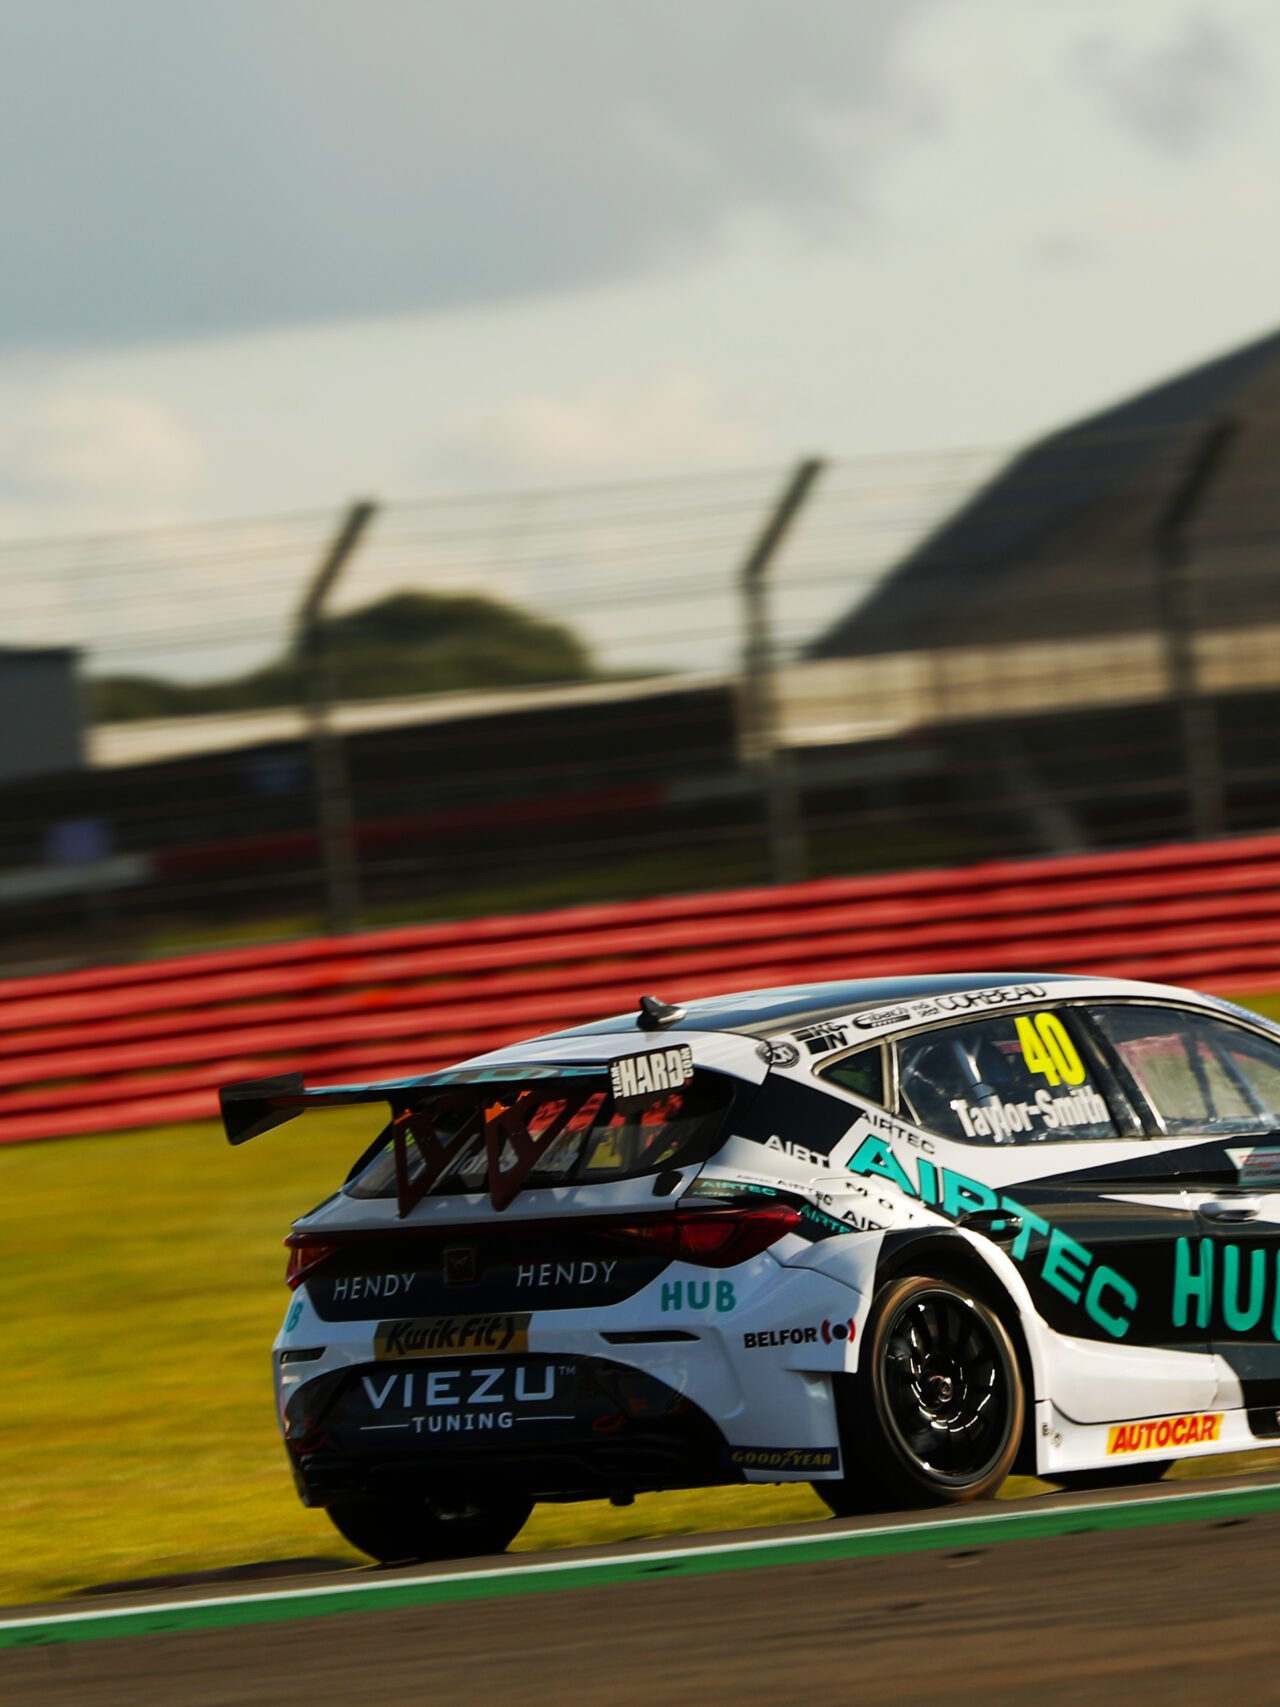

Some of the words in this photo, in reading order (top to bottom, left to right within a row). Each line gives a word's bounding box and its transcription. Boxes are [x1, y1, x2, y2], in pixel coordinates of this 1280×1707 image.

[1014, 1011, 1087, 1087] 40
[619, 1050, 685, 1098] HARD
[952, 1085, 1111, 1143] Taylor-Smith
[861, 1111, 935, 1155] AIRTEC
[701, 1180, 777, 1197] AIRTEC
[846, 1133, 1138, 1338] AIRTEC
[333, 1273, 417, 1301] HENDY
[516, 1260, 618, 1288] HENDY
[660, 1280, 737, 1313] HUB
[743, 1326, 818, 1349] BELFOR
[361, 1366, 555, 1410] VIEZU
[412, 1411, 515, 1434] TUNING
[1110, 1414, 1218, 1454] AUTOCAR
[731, 1450, 832, 1468] GOODYEAR
